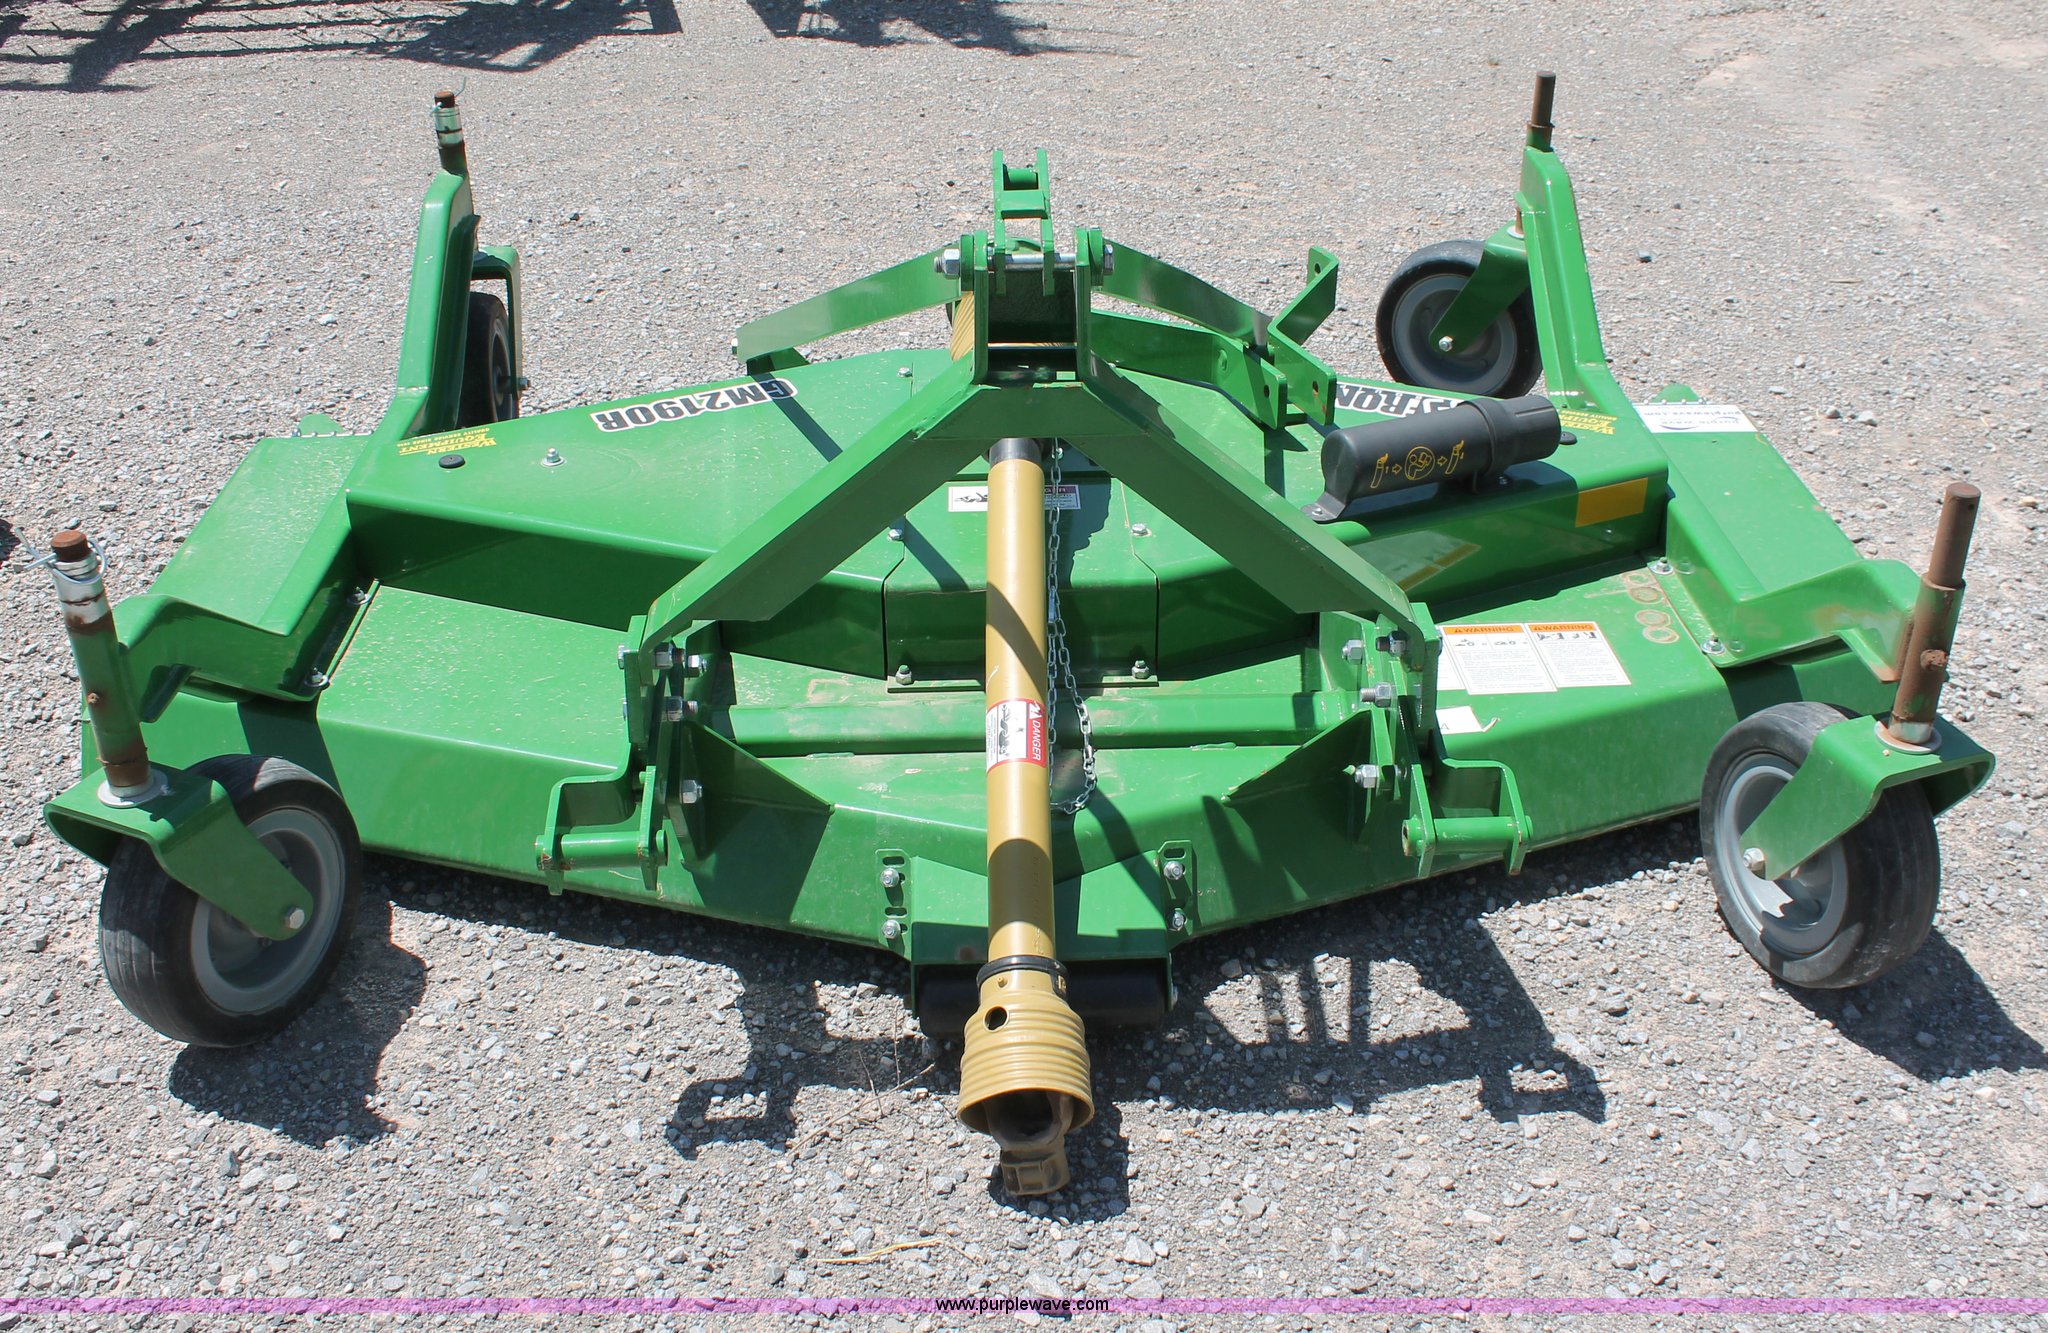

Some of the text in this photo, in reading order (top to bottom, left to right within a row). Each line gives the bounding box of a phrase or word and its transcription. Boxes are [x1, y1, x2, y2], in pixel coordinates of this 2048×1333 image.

[592, 379, 797, 431] GM2190R
[399, 433, 489, 454] EQUIPMENT
[427, 436, 497, 455] WESTERN
[1032, 719, 1042, 761] DANGER
